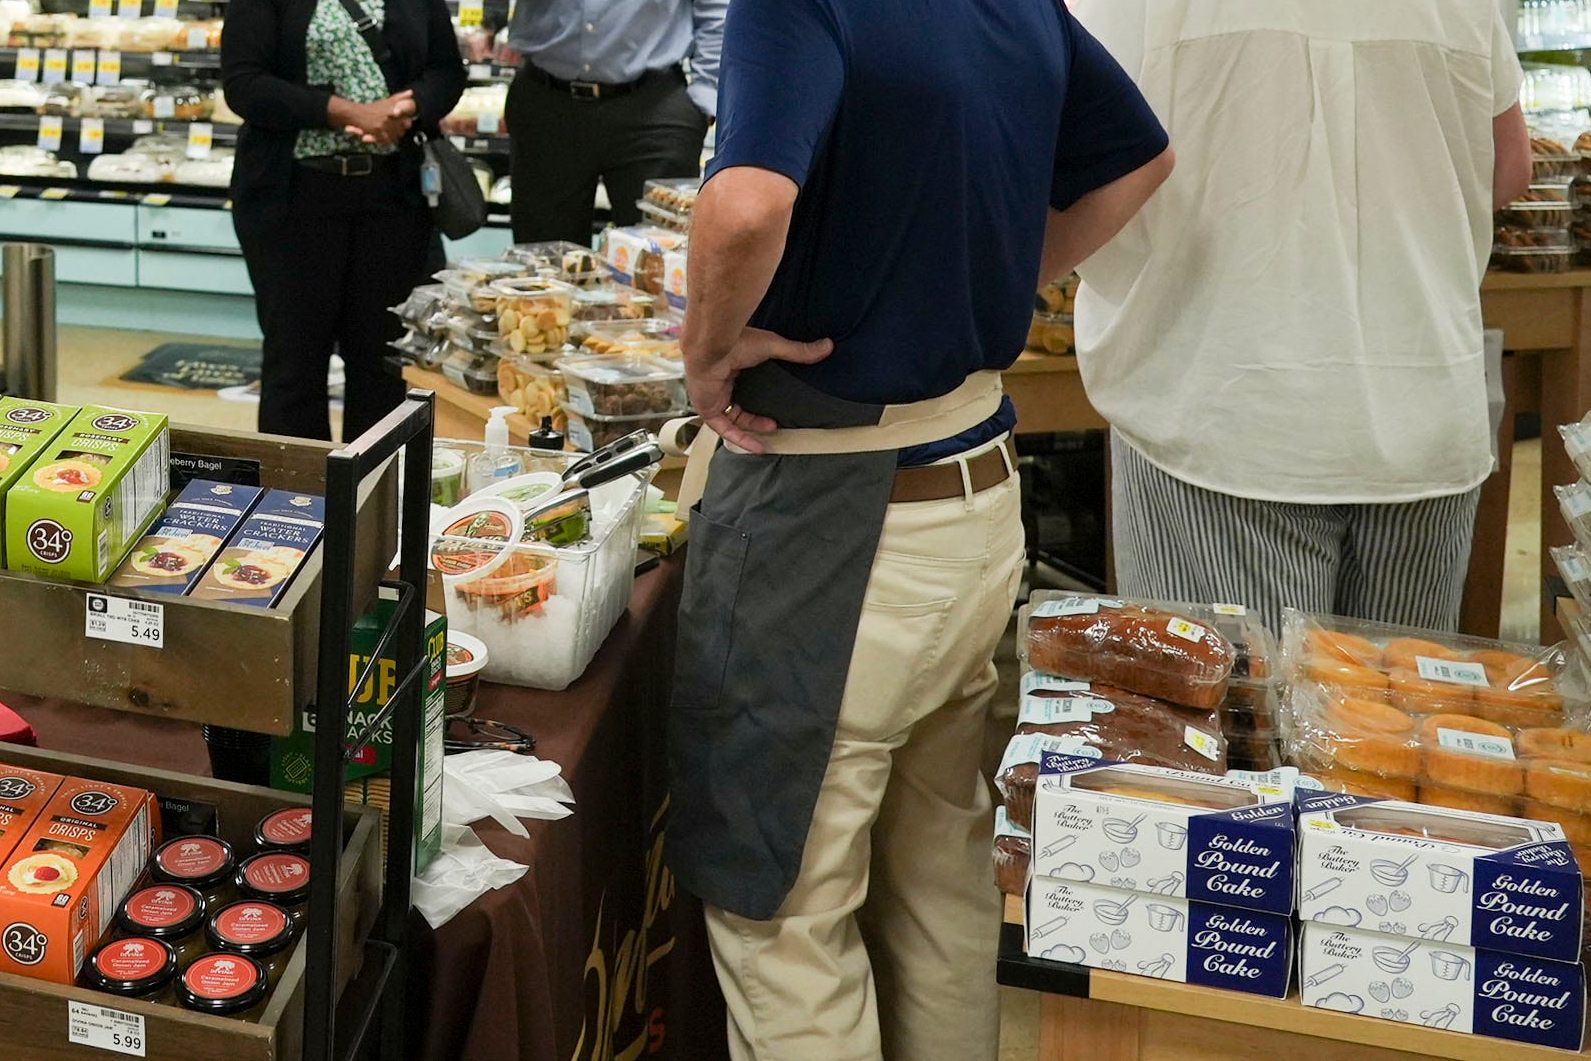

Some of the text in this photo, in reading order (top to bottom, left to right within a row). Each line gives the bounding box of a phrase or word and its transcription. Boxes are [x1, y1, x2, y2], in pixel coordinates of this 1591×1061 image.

[70, 438, 120, 452] CRISPS
[169, 457, 222, 471] eberry Bagel
[179, 509, 226, 519] TRADITIONAL
[179, 514, 220, 525] WATER
[163, 517, 229, 532] CRACKERS
[260, 521, 306, 532] TRADITIONAL
[260, 525, 302, 537] WATER
[33, 527, 73, 553] 34°
[243, 529, 309, 544] CRACKERS
[39, 550, 58, 558] CRISPS
[131, 625, 160, 641] 5.49
[1046, 758, 1090, 770] Buttery
[1047, 754, 1069, 762] The
[76, 795, 118, 810] 34°
[165, 801, 189, 812] Bagel
[1063, 805, 1084, 814] The
[1304, 795, 1359, 809] Golden
[1053, 811, 1093, 826] Buttery
[1231, 806, 1284, 822] Golden
[60, 817, 98, 829] ORIGINAL
[48, 823, 97, 841] CRISPS
[1208, 833, 1272, 857] Golden
[1327, 845, 1348, 856] The
[1194, 850, 1281, 880] Pound
[1317, 852, 1360, 868] Buttery
[1058, 886, 1074, 896] The
[1206, 874, 1266, 899] Cake
[1492, 873, 1559, 899] Golden
[1045, 891, 1085, 907] Buttery
[1476, 891, 1570, 922] Pound
[1205, 914, 1267, 937] Golden
[1489, 916, 1553, 942] Cake
[8, 930, 48, 955] 34°
[1330, 931, 1352, 942] The
[1191, 930, 1277, 959] Pound
[1320, 939, 1362, 954] Buttery
[1203, 953, 1262, 980] Cake
[1492, 961, 1561, 987] Golden
[1478, 979, 1571, 1011] Pound
[1491, 1004, 1555, 1031] Cake
[113, 1033, 141, 1050] 5.99
